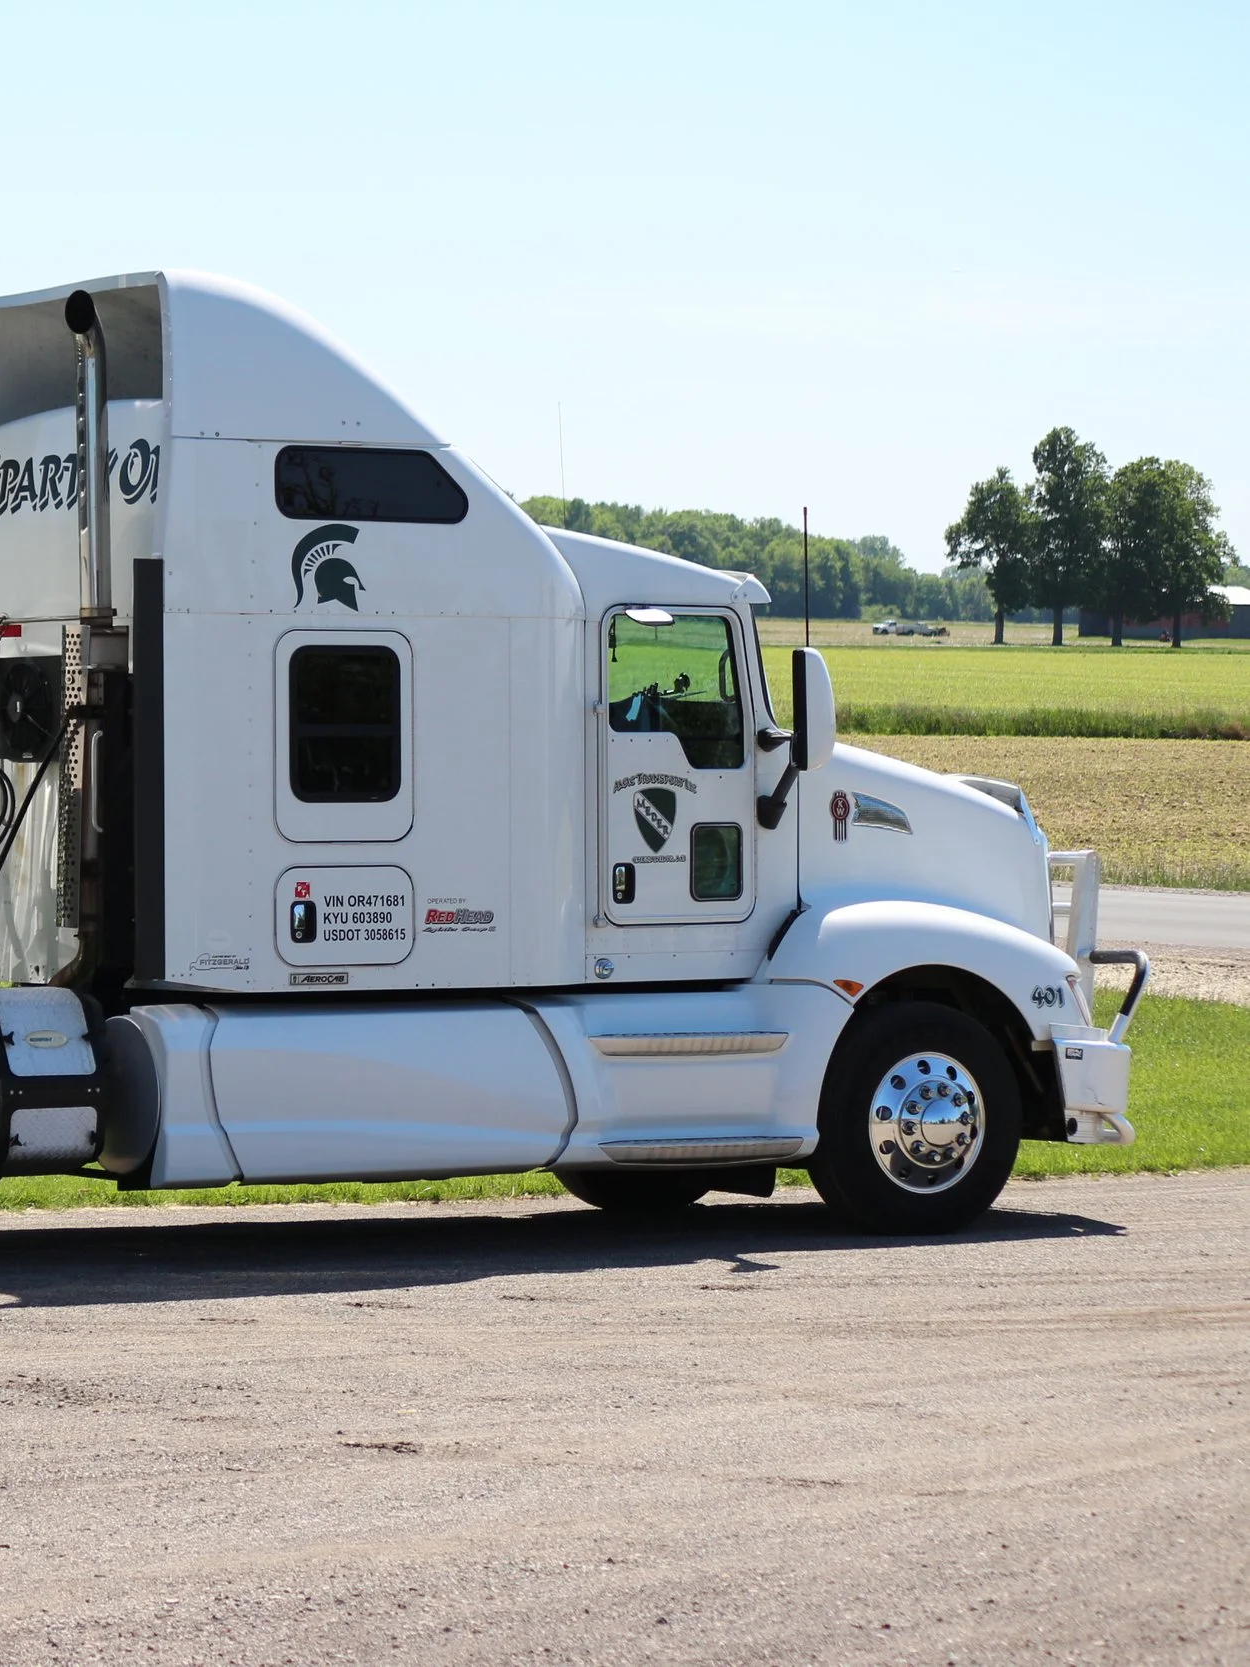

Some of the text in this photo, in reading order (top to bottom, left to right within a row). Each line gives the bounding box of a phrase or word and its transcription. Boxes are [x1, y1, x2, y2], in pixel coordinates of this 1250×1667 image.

[636, 798, 669, 836] MEDER
[324, 895, 405, 907] VIN OR471681
[323, 911, 392, 924] KYU 603890
[323, 928, 406, 941] USDOT 3058615
[199, 957, 250, 966] FITZGERALD
[300, 974, 345, 984] AEROCAB
[1032, 985, 1065, 1008] 401
